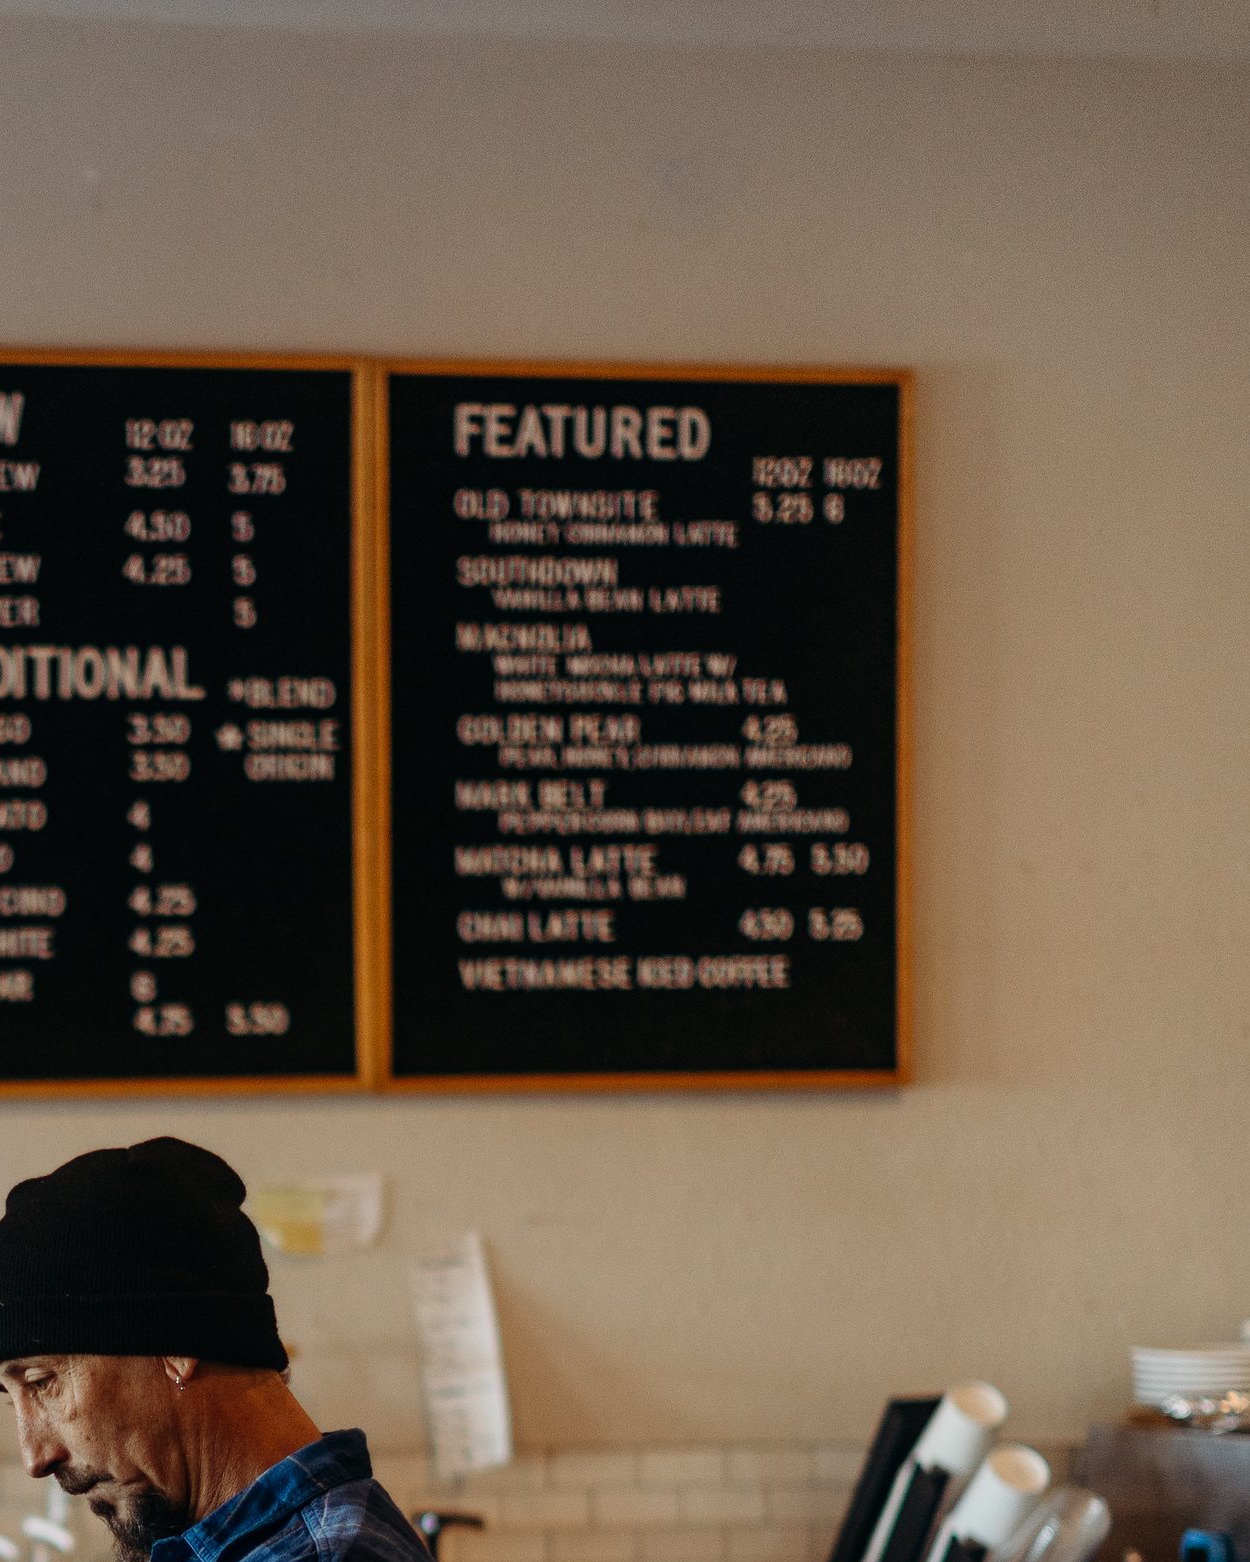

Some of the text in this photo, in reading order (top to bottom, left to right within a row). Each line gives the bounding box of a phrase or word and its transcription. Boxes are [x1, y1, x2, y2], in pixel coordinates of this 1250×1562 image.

[452, 402, 711, 460] FEATURED
[124, 456, 186, 488] 3.25
[227, 463, 287, 495] 3.75
[454, 488, 510, 521] OLD
[123, 509, 192, 543] 4.50
[231, 509, 254, 543] 5
[122, 554, 192, 586] 4.25
[232, 554, 256, 587] 5
[233, 596, 257, 629] 5
[126, 712, 192, 745] 3.50
[570, 843, 658, 877] LATTE
[528, 909, 616, 943] LATTE
[458, 955, 635, 990] VIETNAMESE
